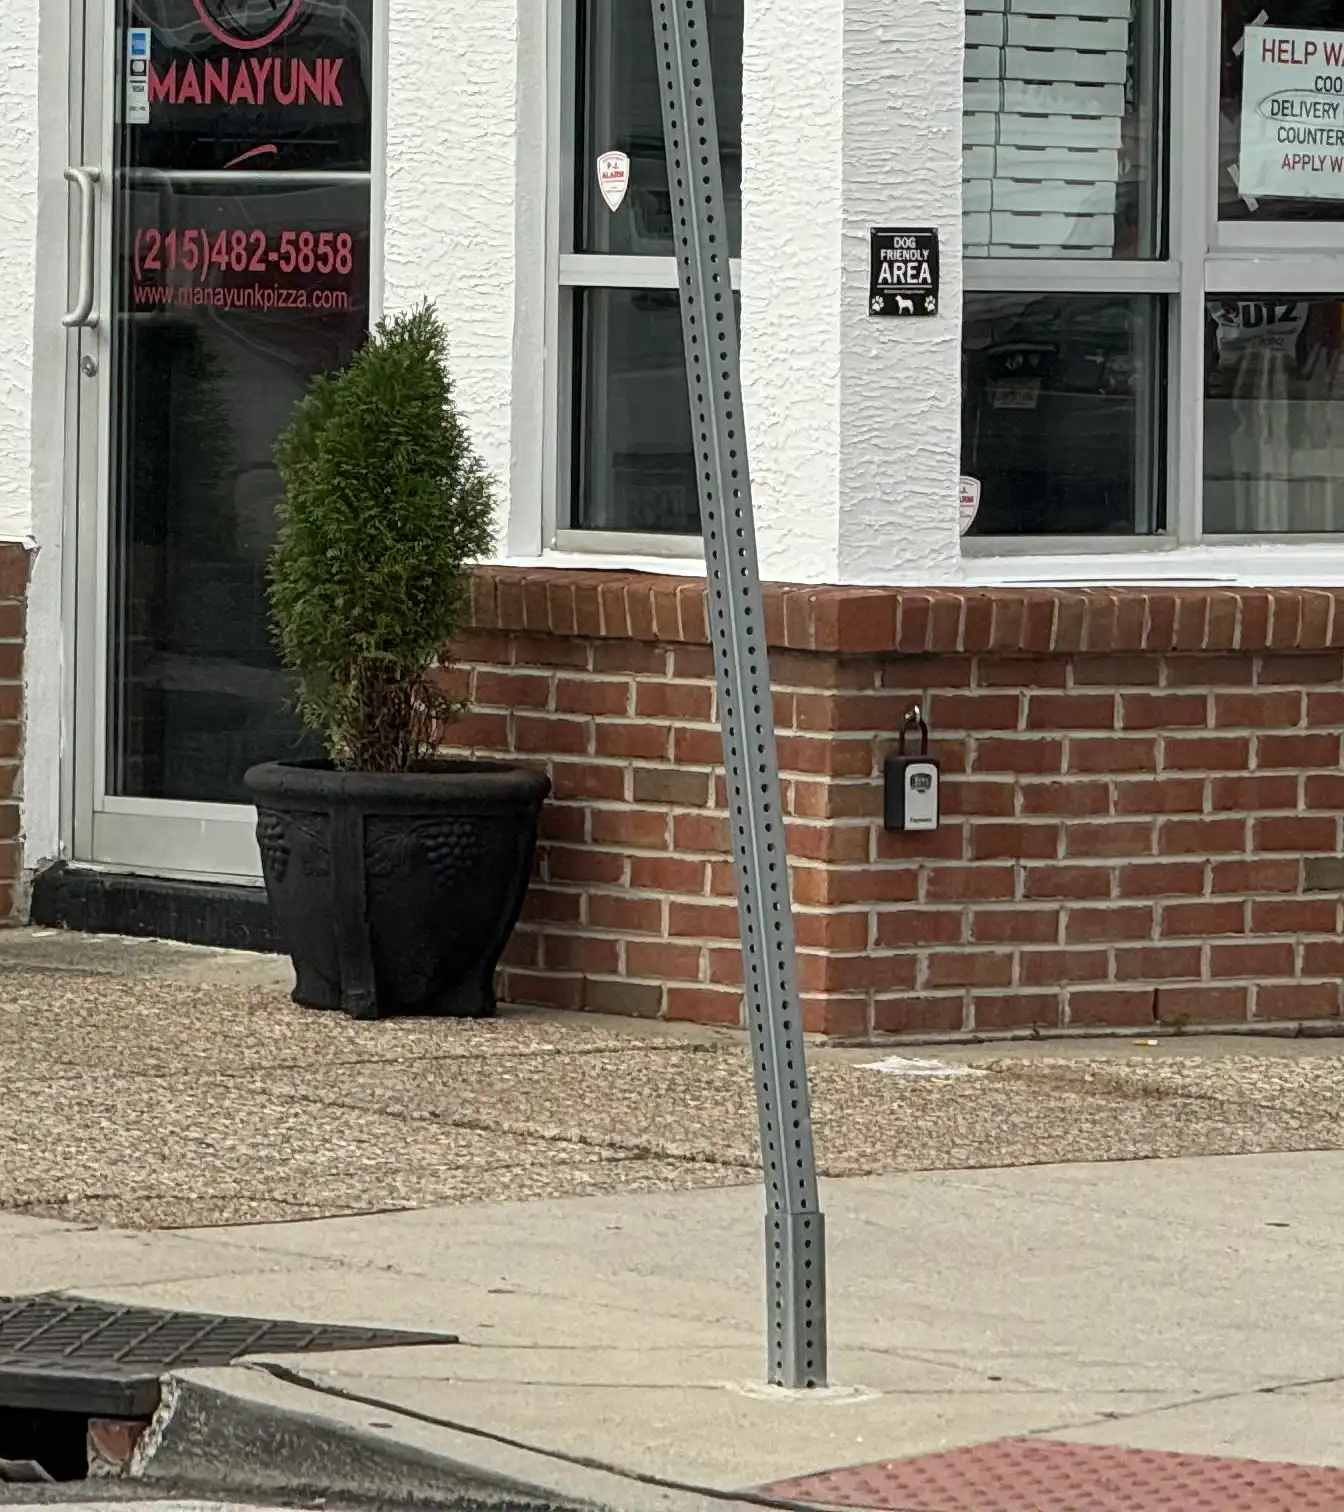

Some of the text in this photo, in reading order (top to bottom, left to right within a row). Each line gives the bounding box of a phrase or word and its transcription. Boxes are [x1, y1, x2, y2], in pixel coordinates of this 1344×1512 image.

[1262, 38, 1318, 65] HELP
[148, 57, 344, 106] MANAYUNK
[1270, 99, 1340, 120] DELIVERY
[1277, 126, 1344, 147] COUNTER
[1281, 153, 1326, 172] APPLY
[893, 236, 917, 248] DOG
[134, 228, 352, 282] (215)482-5858
[880, 249, 929, 261] FRIENDLY
[877, 262, 932, 284] AREA
[134, 283, 348, 313] www.manayunkpizza.com
